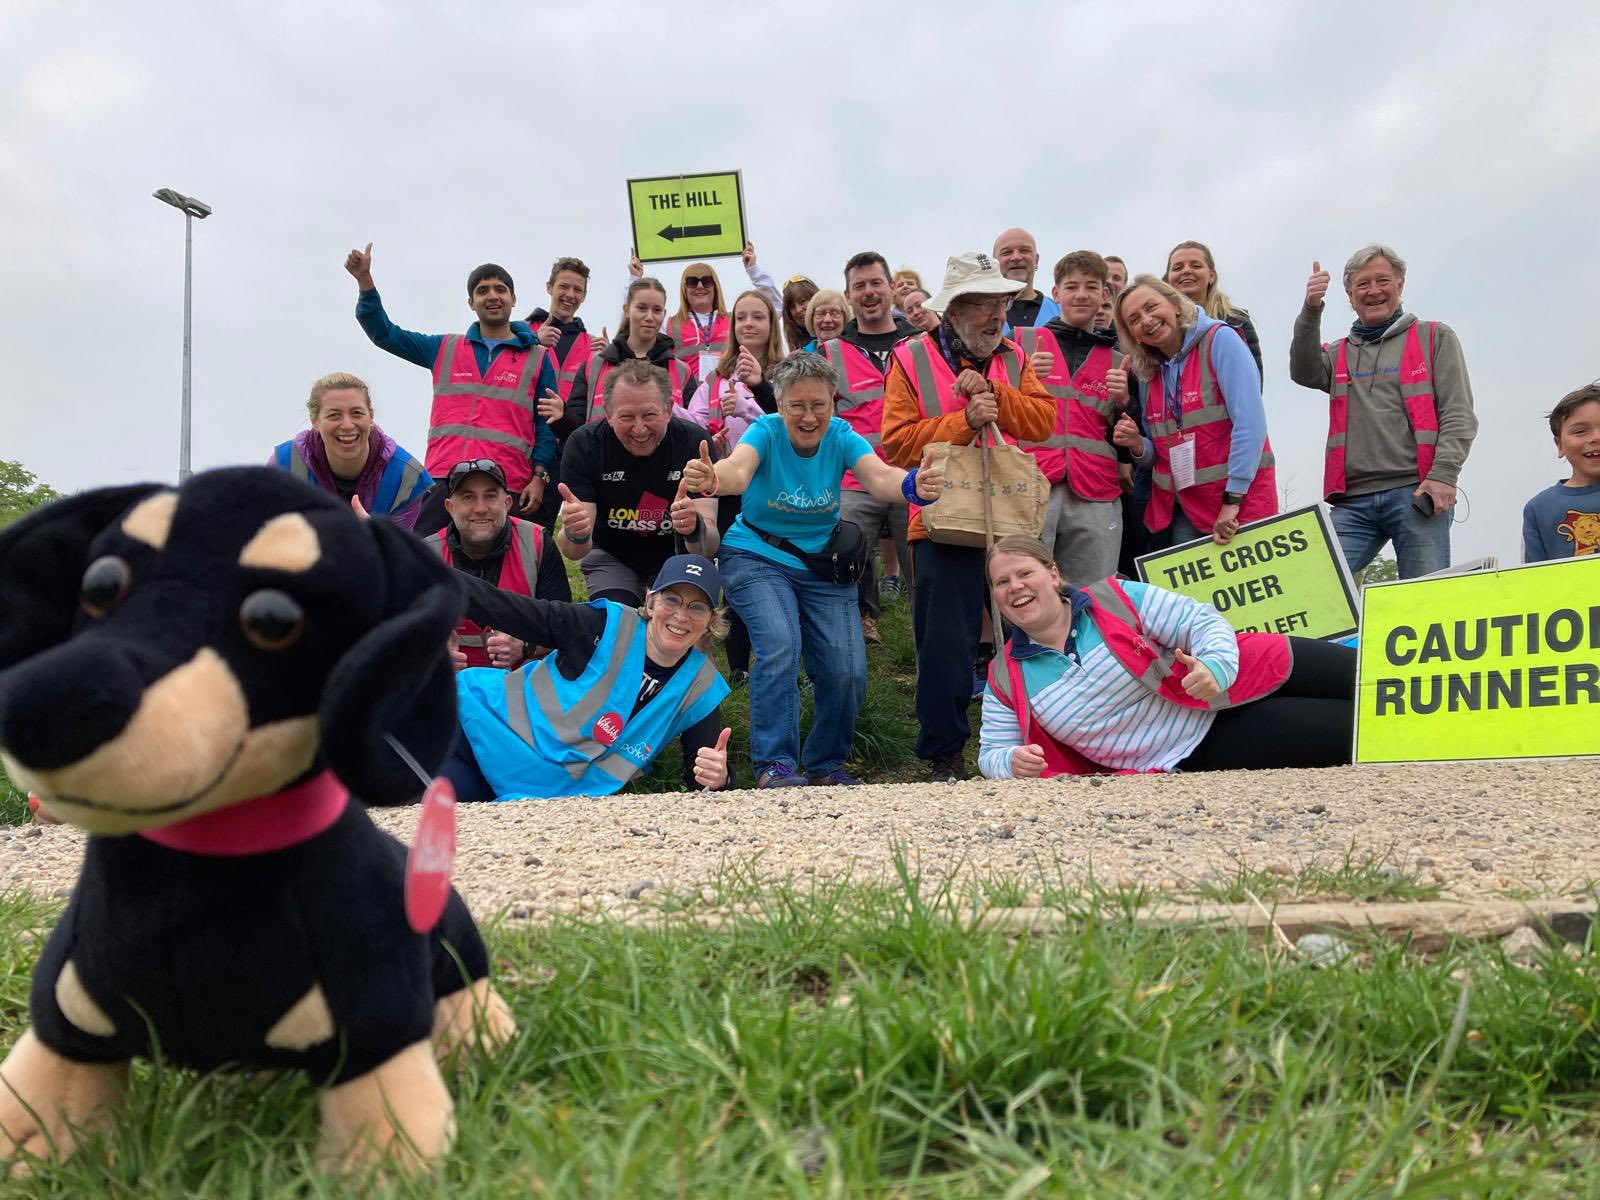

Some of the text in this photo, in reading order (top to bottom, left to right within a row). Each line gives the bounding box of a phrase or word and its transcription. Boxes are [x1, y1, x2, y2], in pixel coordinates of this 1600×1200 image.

[649, 190, 722, 210] THE HILL
[776, 484, 834, 508] parkwalk
[607, 519, 673, 531] CLASS O
[608, 508, 671, 520] LONDON
[1163, 529, 1309, 589] THE CROSS
[1212, 574, 1284, 612] OVER
[1264, 610, 1308, 635] LEFT
[1385, 606, 1600, 666] CAUTIO
[596, 715, 620, 743] Vitality
